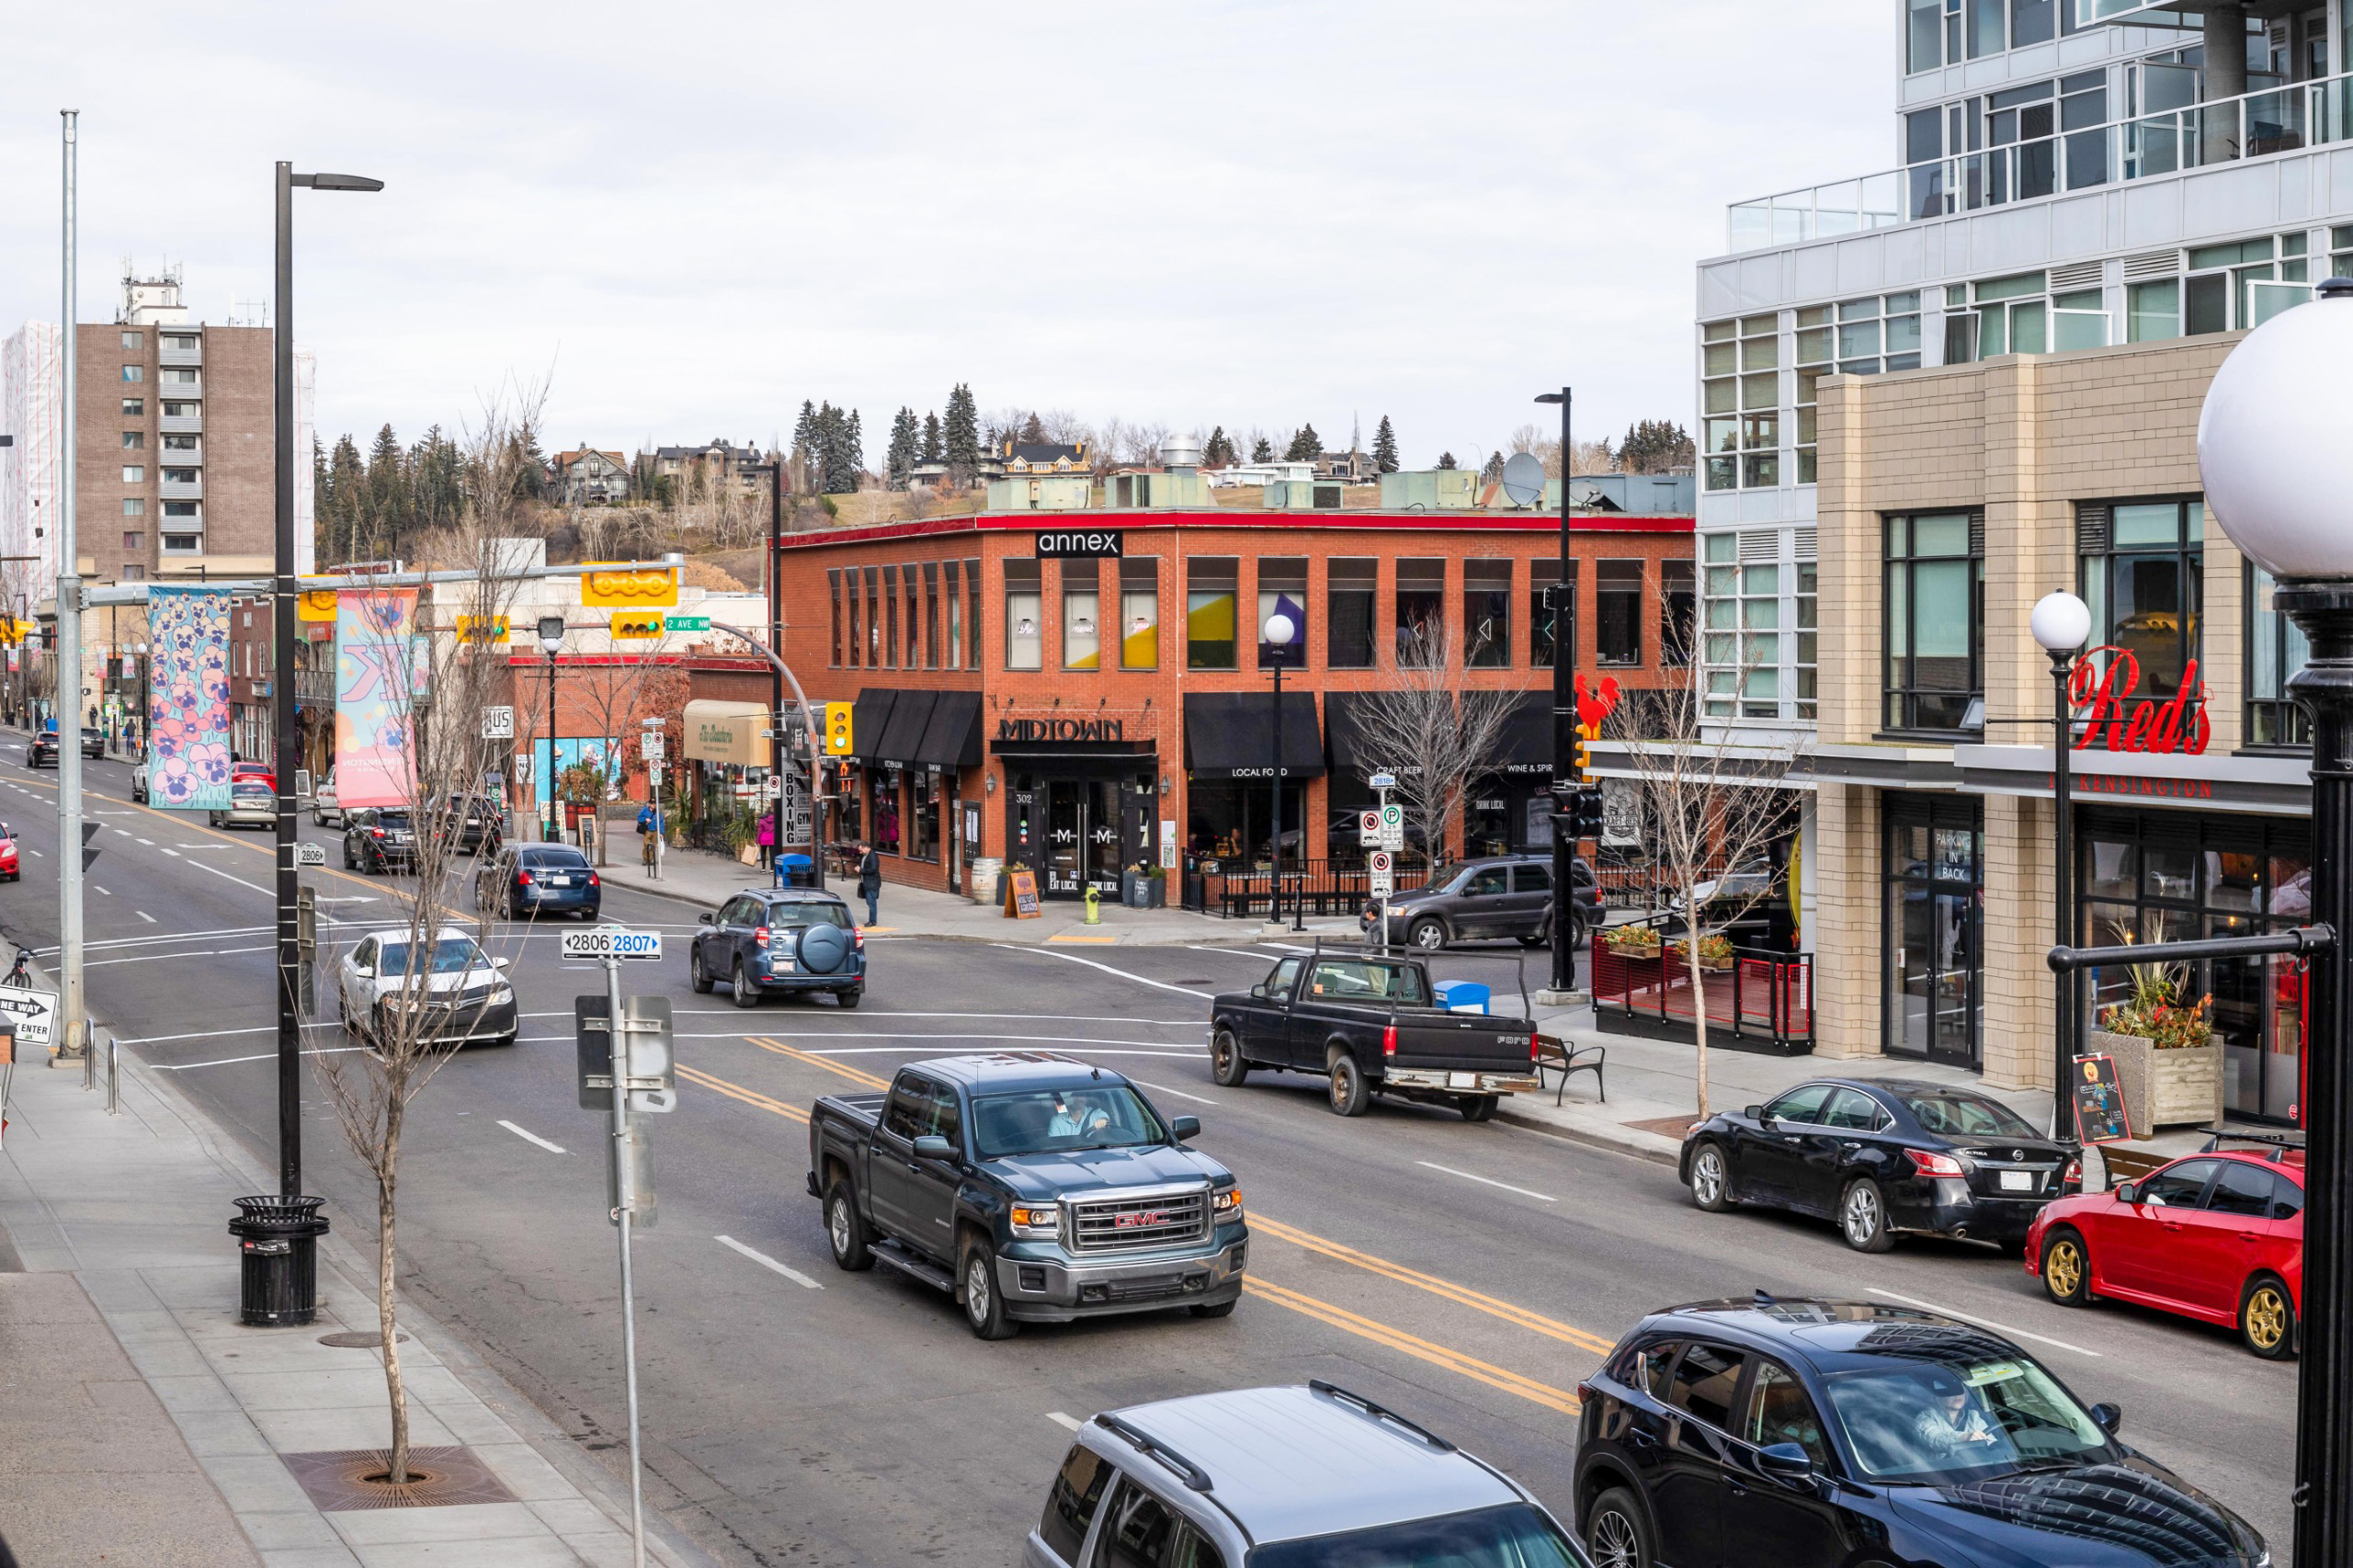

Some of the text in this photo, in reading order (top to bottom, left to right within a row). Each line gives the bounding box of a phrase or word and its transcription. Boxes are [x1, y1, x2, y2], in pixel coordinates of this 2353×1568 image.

[1039, 533, 1119, 553] annex
[667, 619, 710, 629] 2 AVE NW
[1017, 622, 1035, 634] the
[2068, 644, 2211, 756] Red's
[998, 719, 1123, 742] MIDTOWN
[1232, 768, 1260, 777] LOCAL
[1507, 765, 1528, 773] WINE
[2079, 773, 2211, 799] KENSINGTON
[1017, 794, 1032, 803] 302
[786, 773, 794, 844] BOXING
[1476, 800, 1506, 810] DRINK LOCAL
[1388, 811, 1396, 821] P
[1603, 815, 1638, 826] CRAFT BEE
[1057, 829, 1071, 843] M
[1097, 830, 1110, 844] M
[1936, 833, 1971, 846] PARKING
[301, 850, 320, 860] 2806
[1949, 851, 1958, 863] IN
[1942, 867, 1965, 881] BACK
[1050, 881, 1078, 891] EAT LOCAL
[1104, 882, 1118, 892] LOCAL
[572, 934, 609, 950] 2806
[613, 935, 651, 951] 2807
[0, 1000, 41, 1015] NE WAY
[21, 1024, 48, 1036] ENTER
[1496, 1036, 1530, 1045] FORD
[1115, 1210, 1171, 1229] GMC
